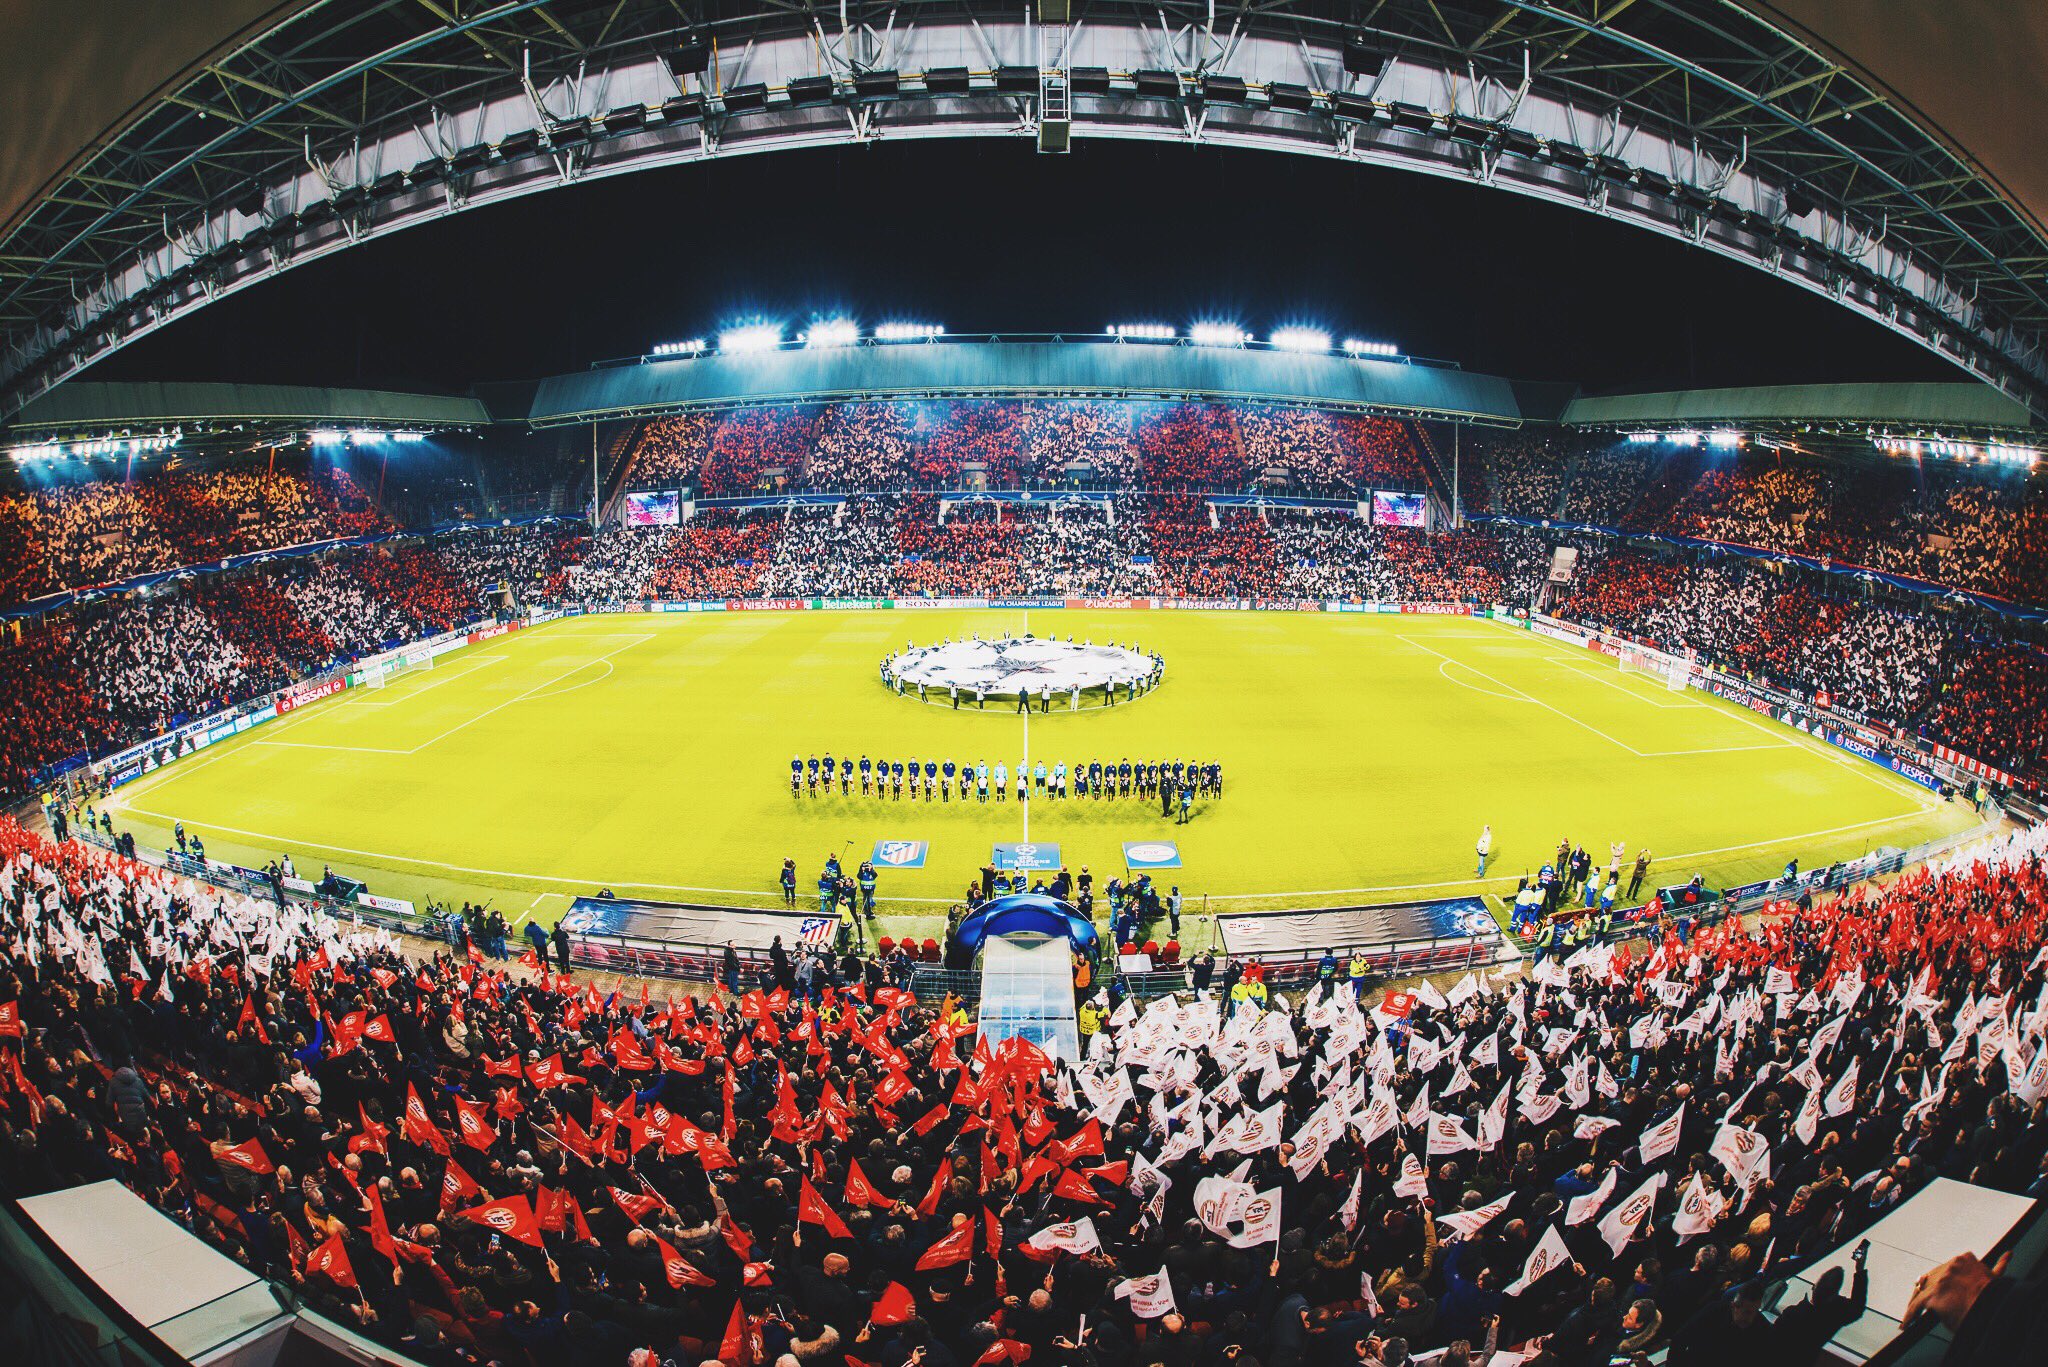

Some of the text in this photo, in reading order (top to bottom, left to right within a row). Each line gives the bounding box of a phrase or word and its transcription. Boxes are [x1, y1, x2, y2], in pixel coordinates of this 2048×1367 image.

[599, 602, 623, 614] pepsi
[743, 601, 785, 610] NISSAN
[822, 600, 873, 609] Heineken
[1094, 600, 1132, 609] UniCredit
[1178, 600, 1238, 610] MasterCard
[1268, 600, 1296, 611] pepsi
[1416, 605, 1454, 615] NISSAN
[530, 611, 564, 626] MasterCard
[291, 686, 332, 708] NISSAN
[1724, 689, 1750, 708] pepsi
[112, 756, 118, 764] In
[120, 746, 144, 762] memory
[144, 744, 151, 752] of
[152, 735, 174, 748] Meneer
[1844, 738, 1877, 760] RESPECT
[118, 766, 140, 781] RESPECT
[1901, 762, 1934, 785] RESPECT
[377, 900, 402, 910] RESPECT
